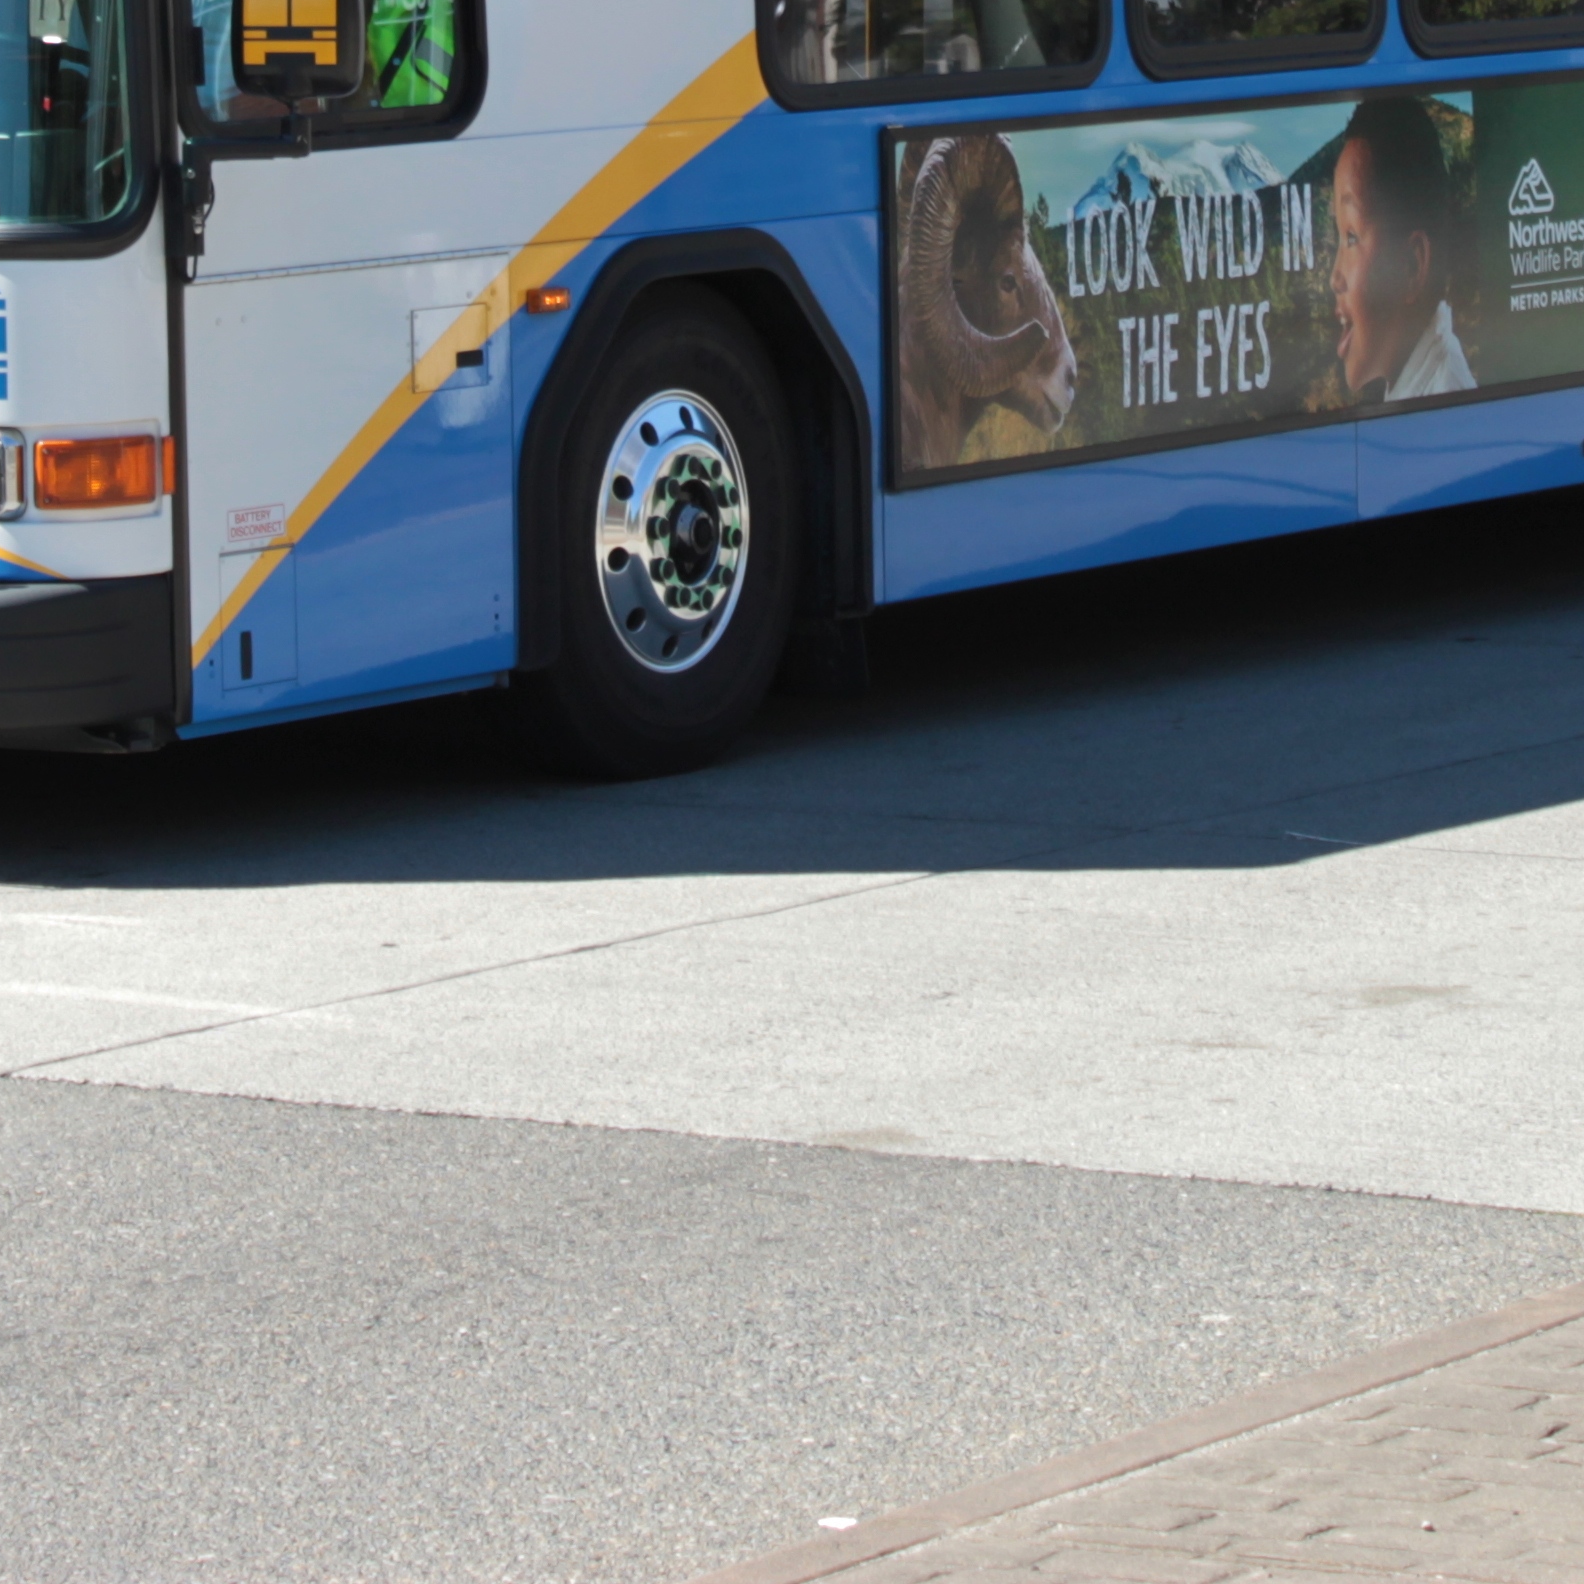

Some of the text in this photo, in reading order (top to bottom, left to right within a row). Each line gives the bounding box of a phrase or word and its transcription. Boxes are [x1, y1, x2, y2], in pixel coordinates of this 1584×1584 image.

[1066, 183, 1314, 298] LOOK WILD IN
[1510, 247, 1561, 276] Wildlife
[1510, 291, 1548, 312] METRO
[1551, 286, 1584, 306] PARKS
[1118, 300, 1271, 409] THE EYES
[230, 521, 282, 538] DISCONNECT
[234, 510, 271, 524] BATTERY
